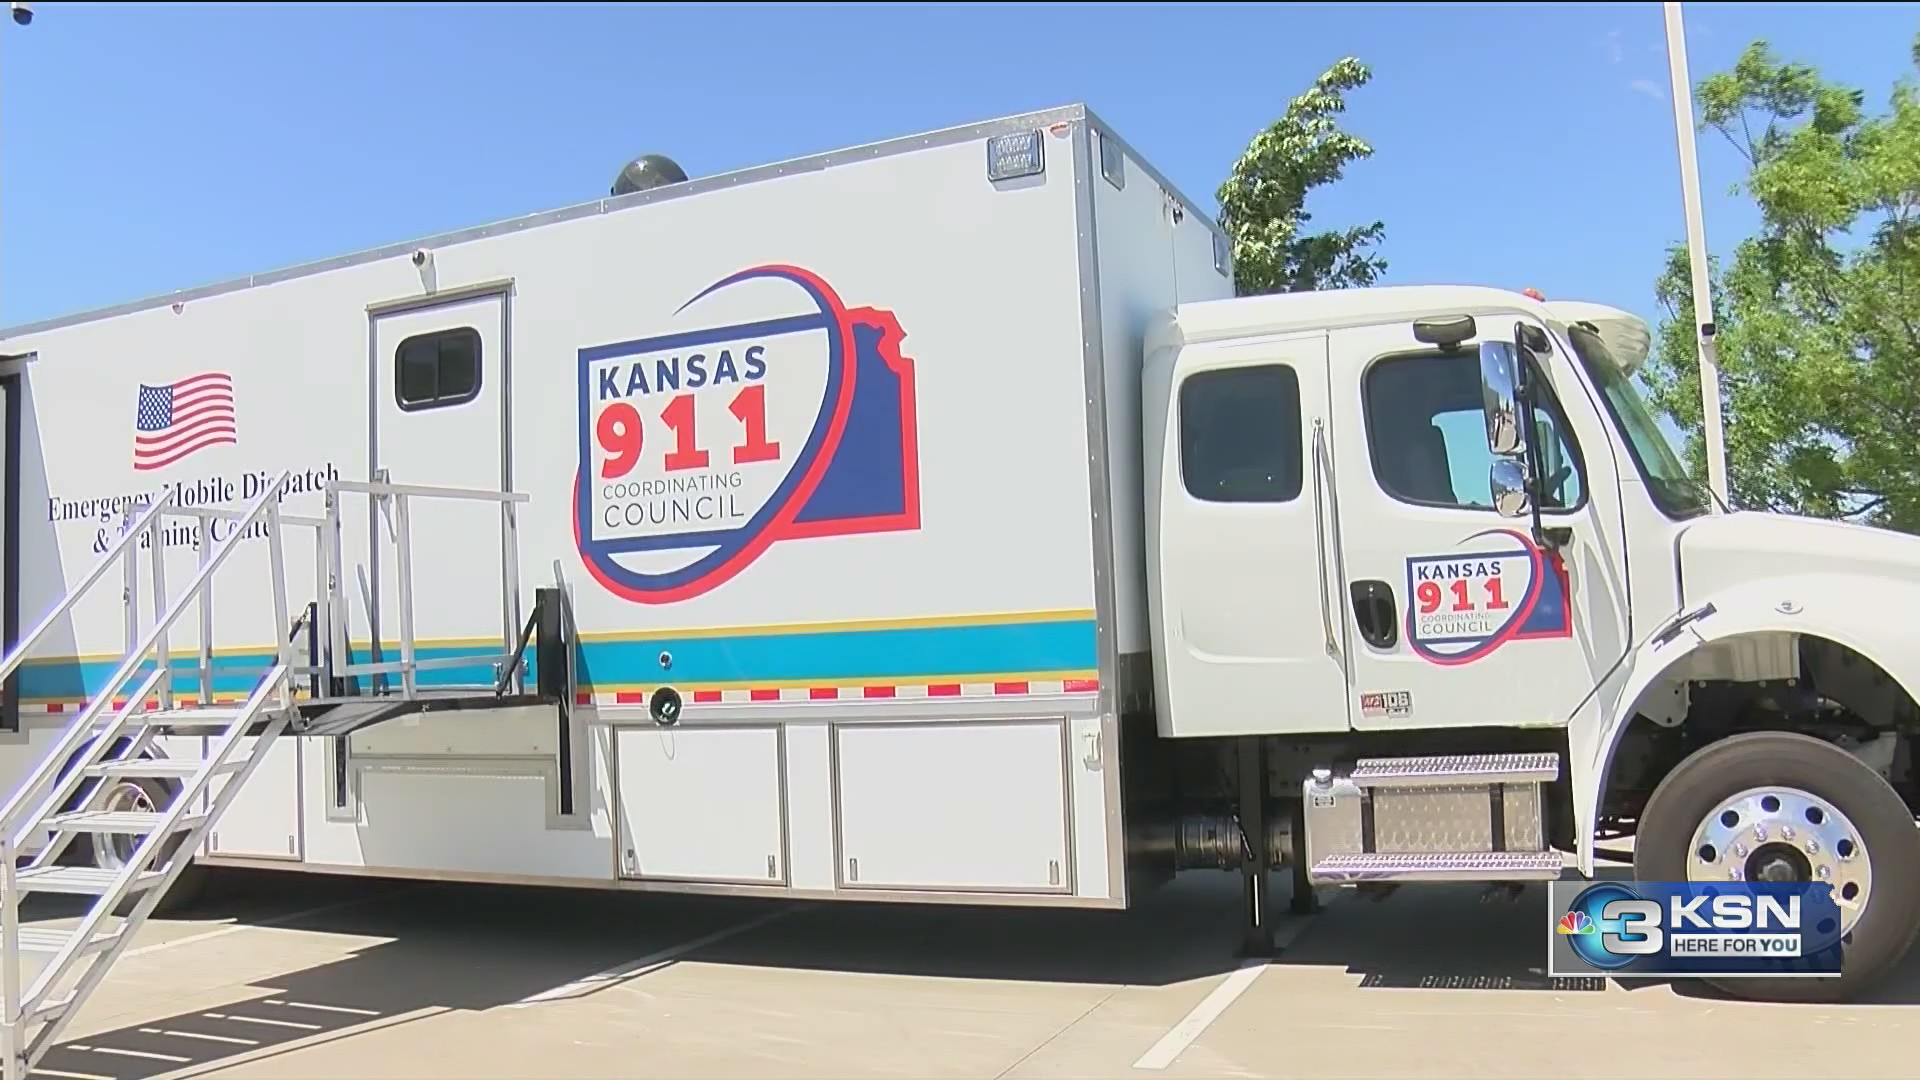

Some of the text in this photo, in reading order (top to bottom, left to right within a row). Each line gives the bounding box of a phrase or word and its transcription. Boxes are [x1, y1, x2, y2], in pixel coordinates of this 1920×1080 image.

[599, 345, 767, 400] KANSAS
[596, 384, 781, 480] 911
[603, 472, 742, 500] COORDINATING
[604, 494, 745, 528] COUNCIL
[92, 527, 109, 553] &
[1417, 561, 1502, 581] KANSAS
[1417, 577, 1509, 614] 911
[1420, 612, 1490, 623] COORDINATING
[1422, 621, 1493, 635] COUNCIL
